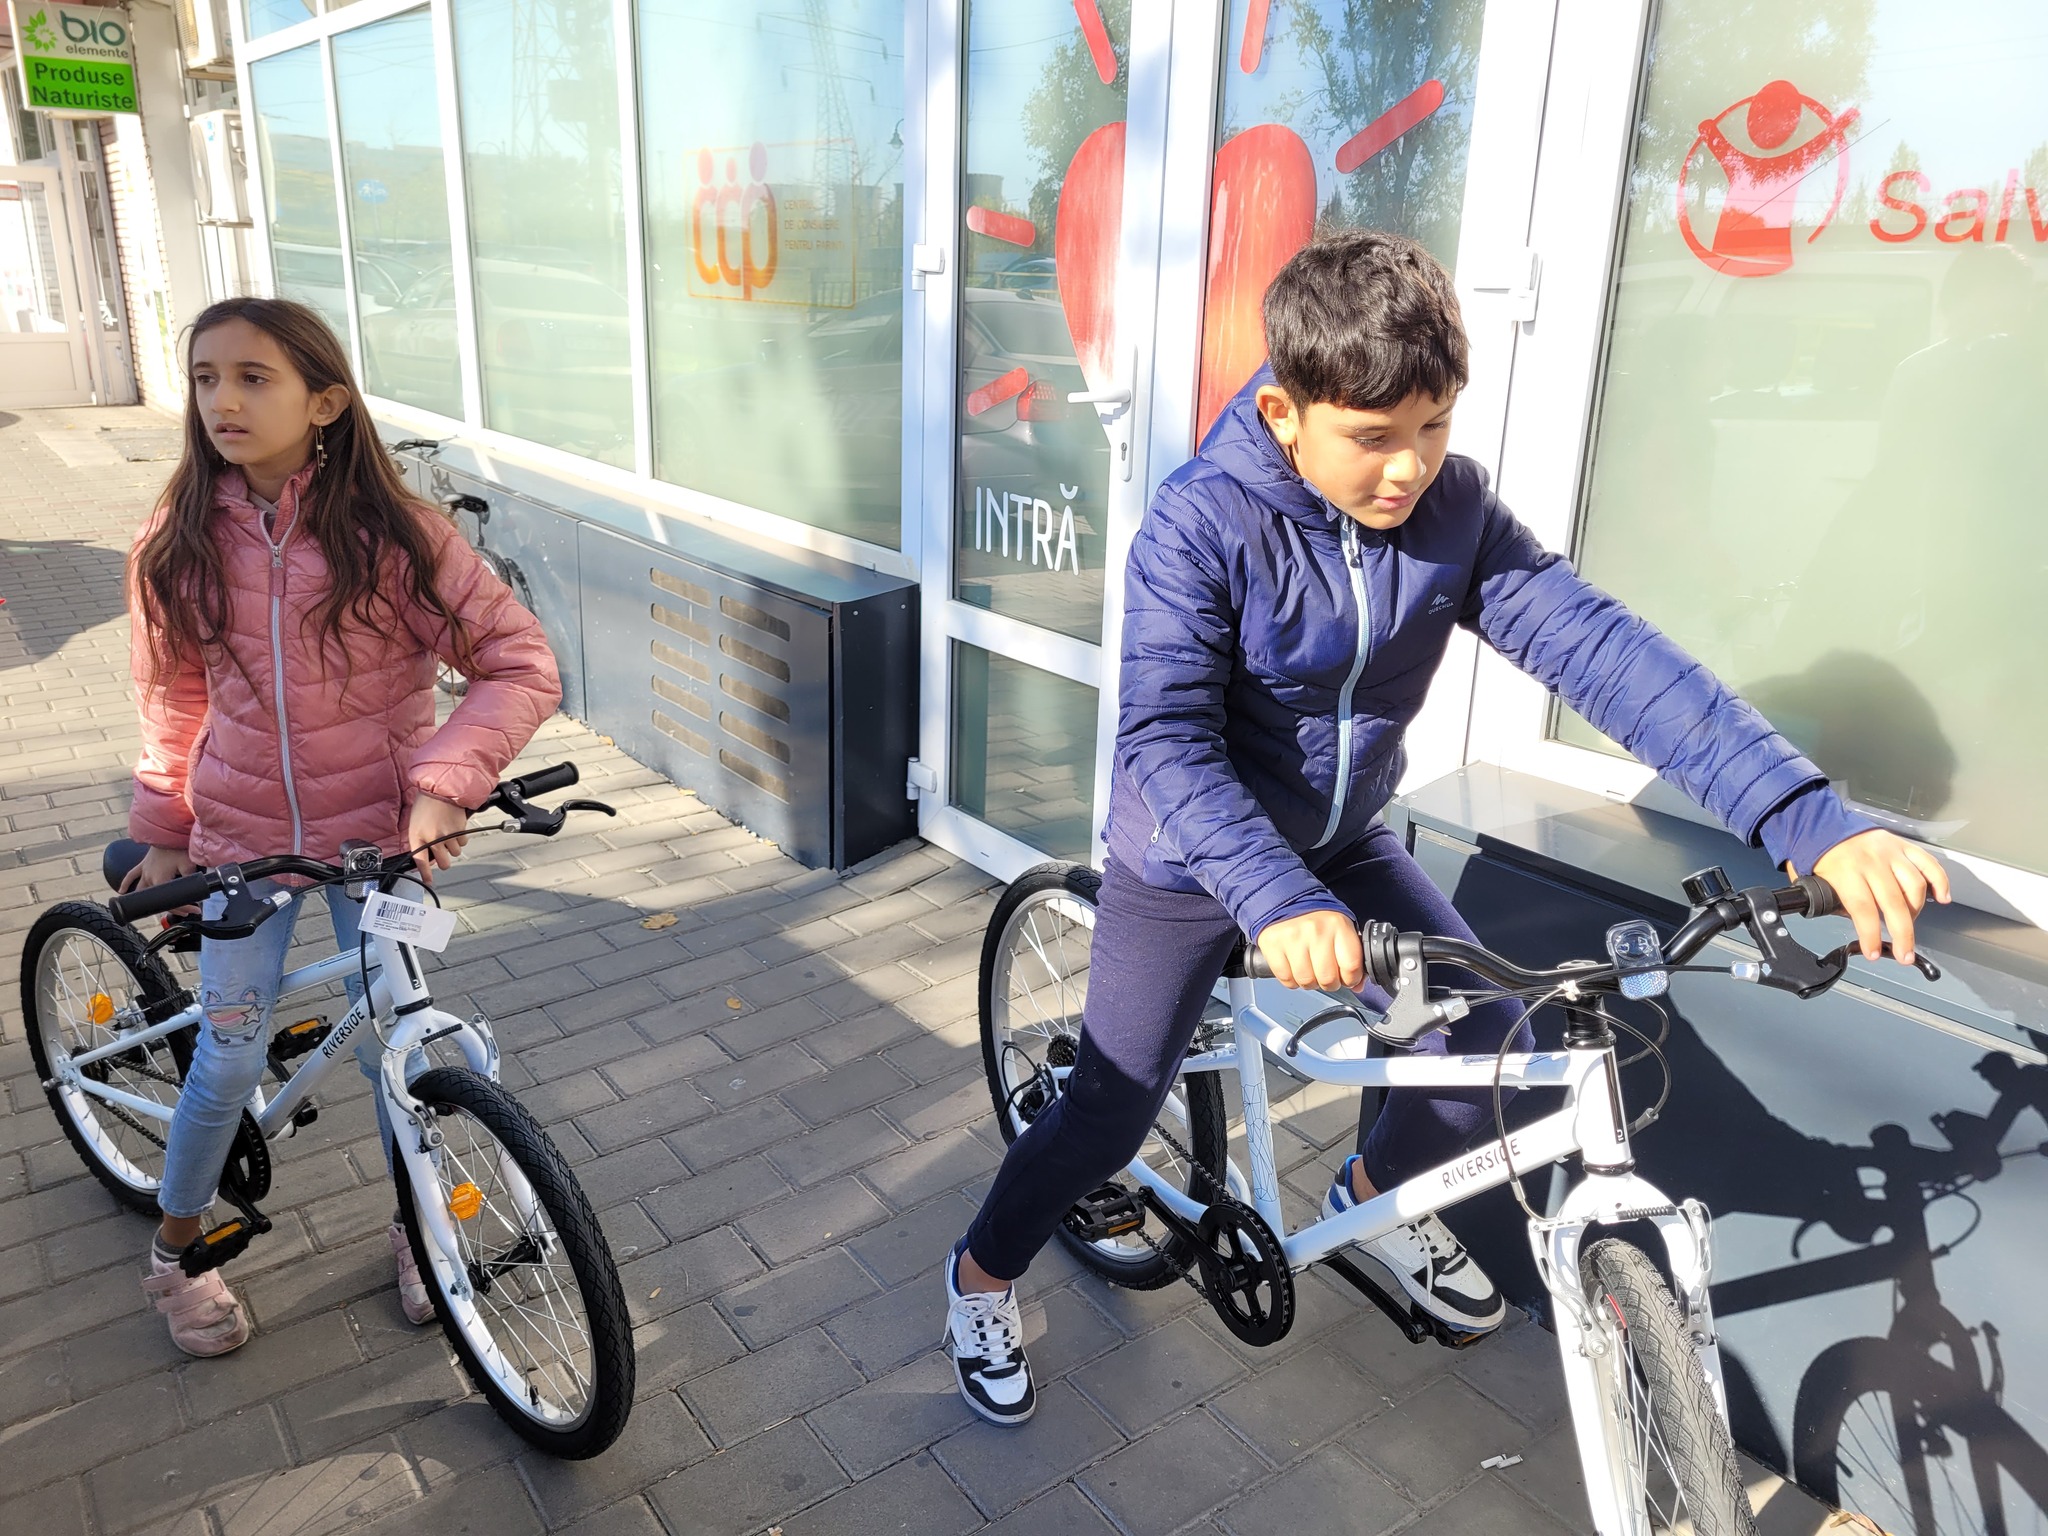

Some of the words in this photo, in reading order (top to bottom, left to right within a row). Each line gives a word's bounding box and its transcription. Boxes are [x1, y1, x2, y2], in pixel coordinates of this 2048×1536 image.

[59, 9, 126, 46] bio
[65, 44, 129, 58] elemente
[34, 62, 125, 86] Produse
[32, 85, 133, 109] Naturiste
[975, 482, 1079, 576] INTRĂ
[1428, 602, 1454, 615] QUECHUA
[322, 1006, 365, 1059] RIVERSIDE
